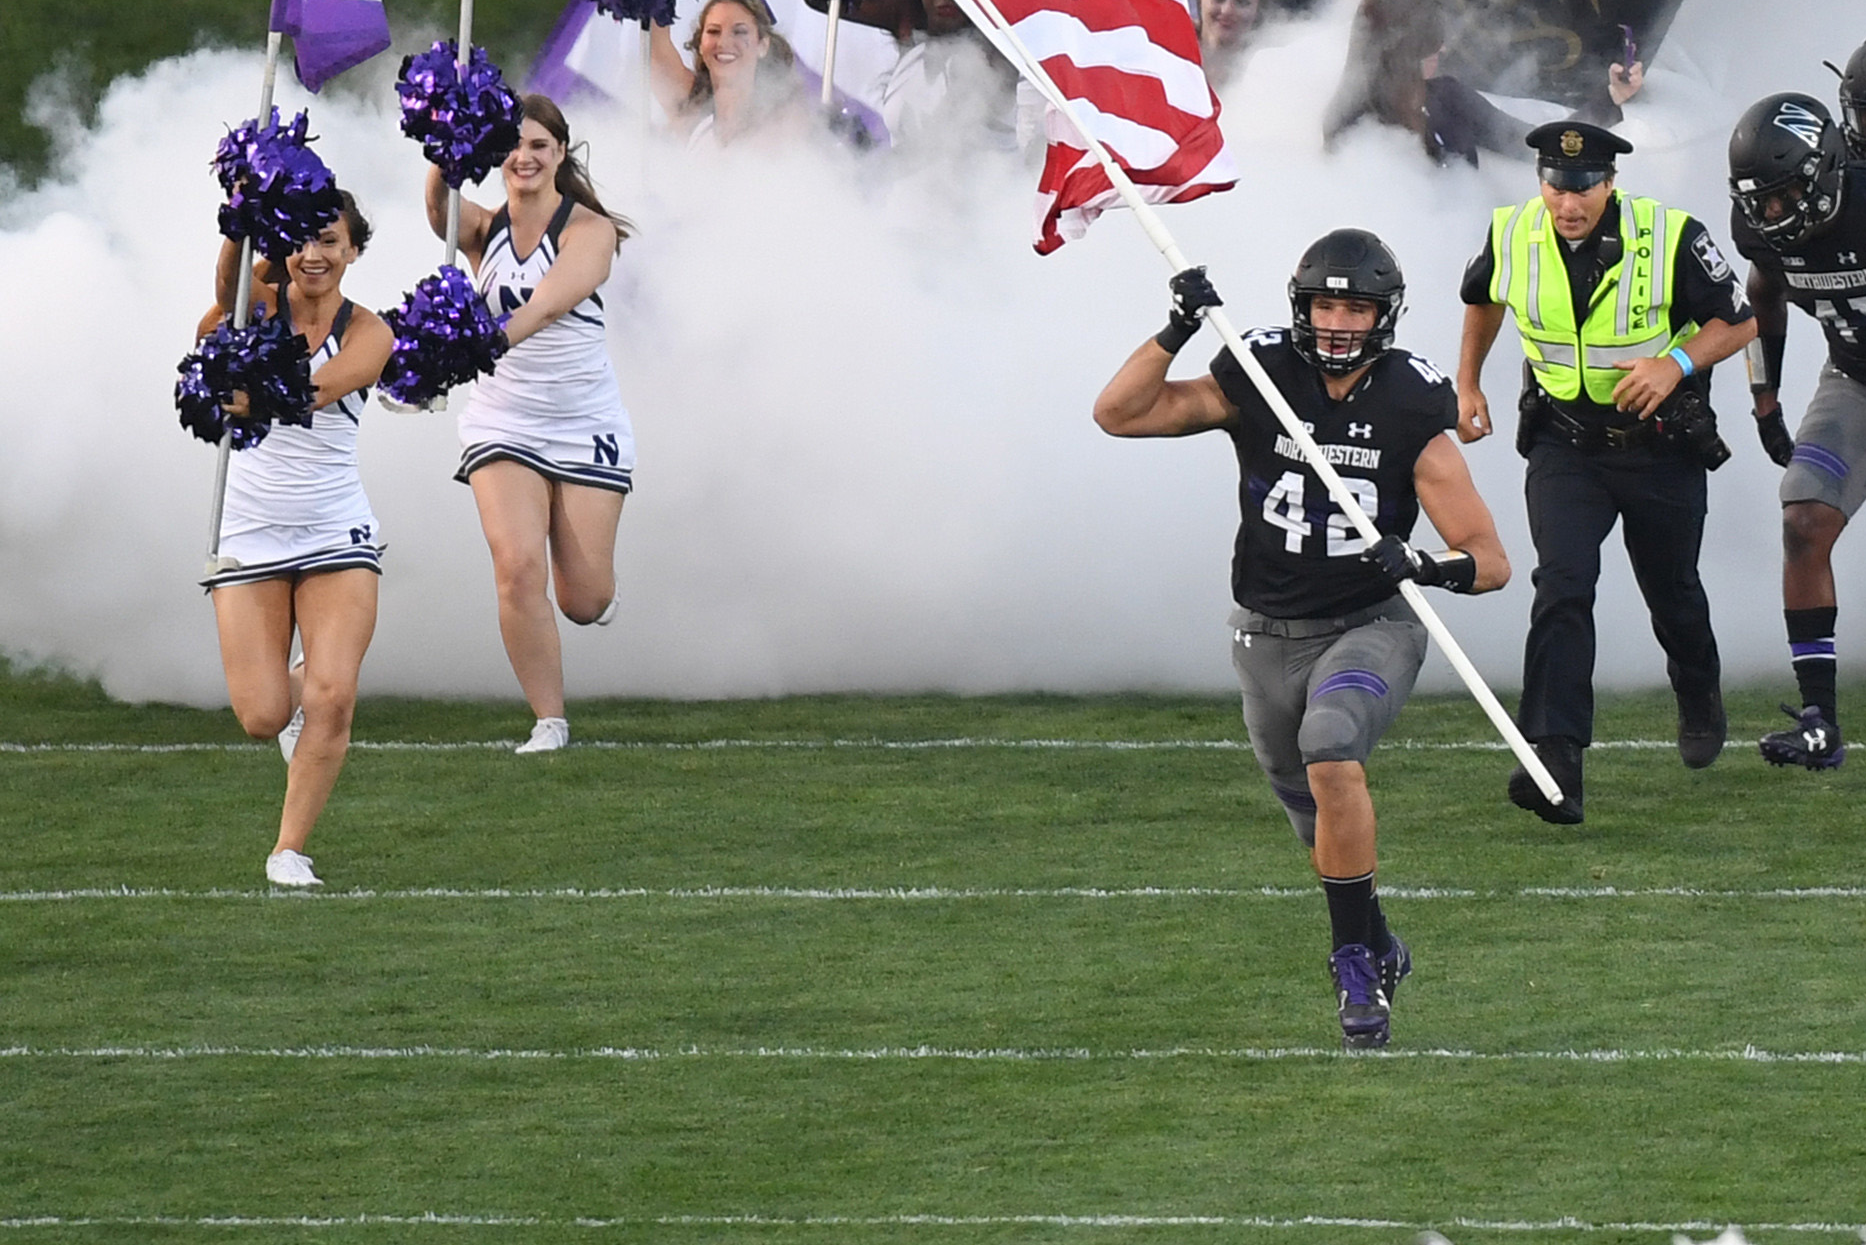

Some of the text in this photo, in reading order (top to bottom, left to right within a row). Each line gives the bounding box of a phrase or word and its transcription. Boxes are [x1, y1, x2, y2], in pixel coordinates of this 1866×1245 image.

[1632, 228, 1652, 330] POLICE
[592, 432, 620, 467] N
[1273, 433, 1382, 470] NORWESTERN
[1262, 470, 1379, 557] 42
